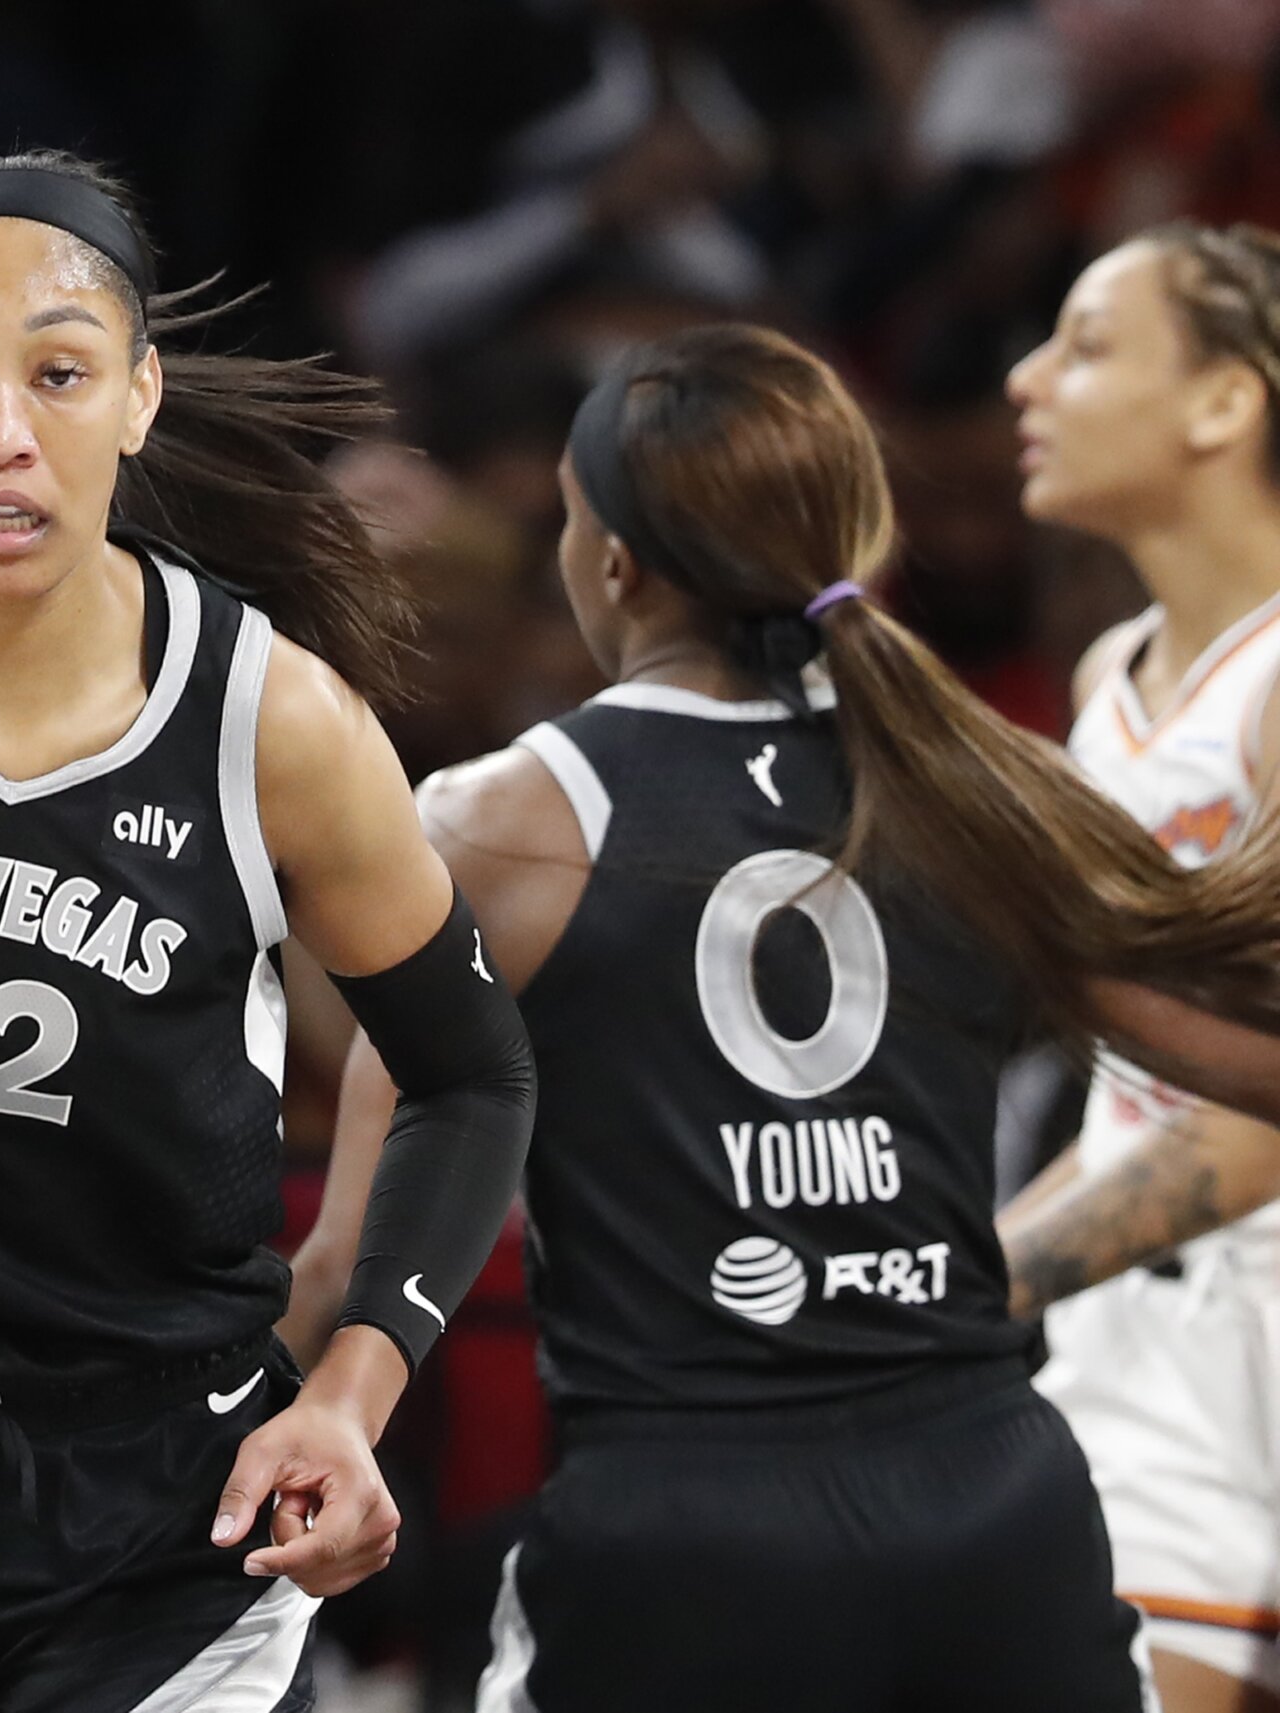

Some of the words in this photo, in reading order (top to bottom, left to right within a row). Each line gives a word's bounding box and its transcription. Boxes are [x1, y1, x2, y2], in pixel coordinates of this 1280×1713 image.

[113, 804, 193, 859] ally
[695, 848, 888, 1099] 0
[719, 1116, 901, 1209] YOUNG
[822, 1242, 951, 1303] AT&T
